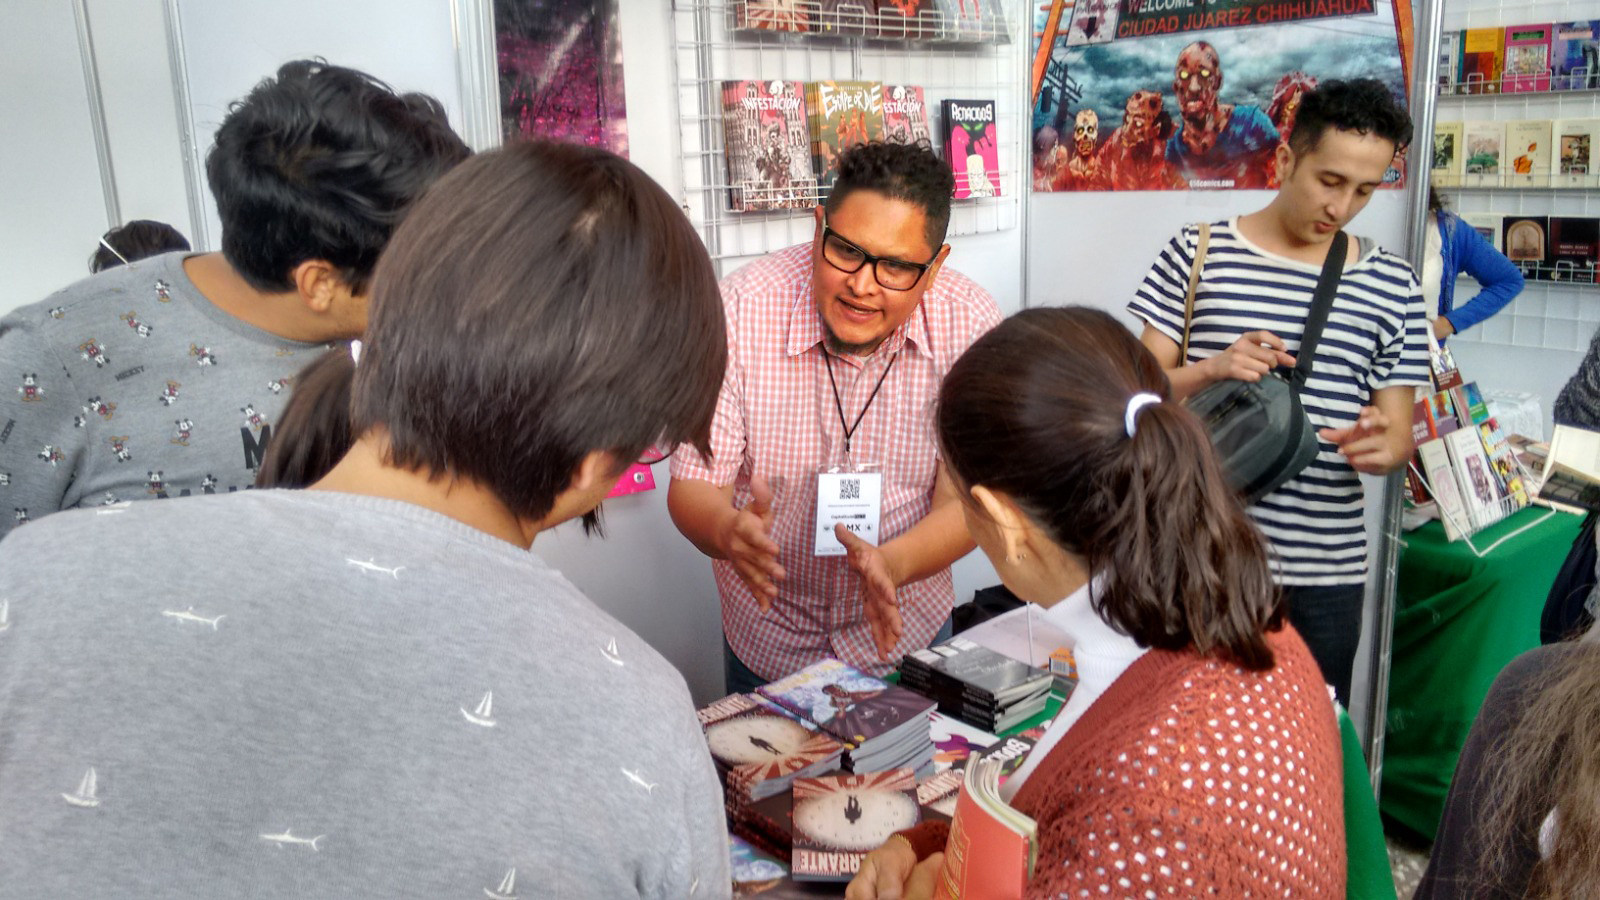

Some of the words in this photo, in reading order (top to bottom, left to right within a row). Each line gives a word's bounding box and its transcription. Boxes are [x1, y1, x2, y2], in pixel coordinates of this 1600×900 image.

[1118, 16, 1179, 38] CIUDAD
[1183, 8, 1251, 30] JUAREZ
[1256, 0, 1372, 23] CHIHUAHUA
[800, 851, 867, 874] RRANTE
